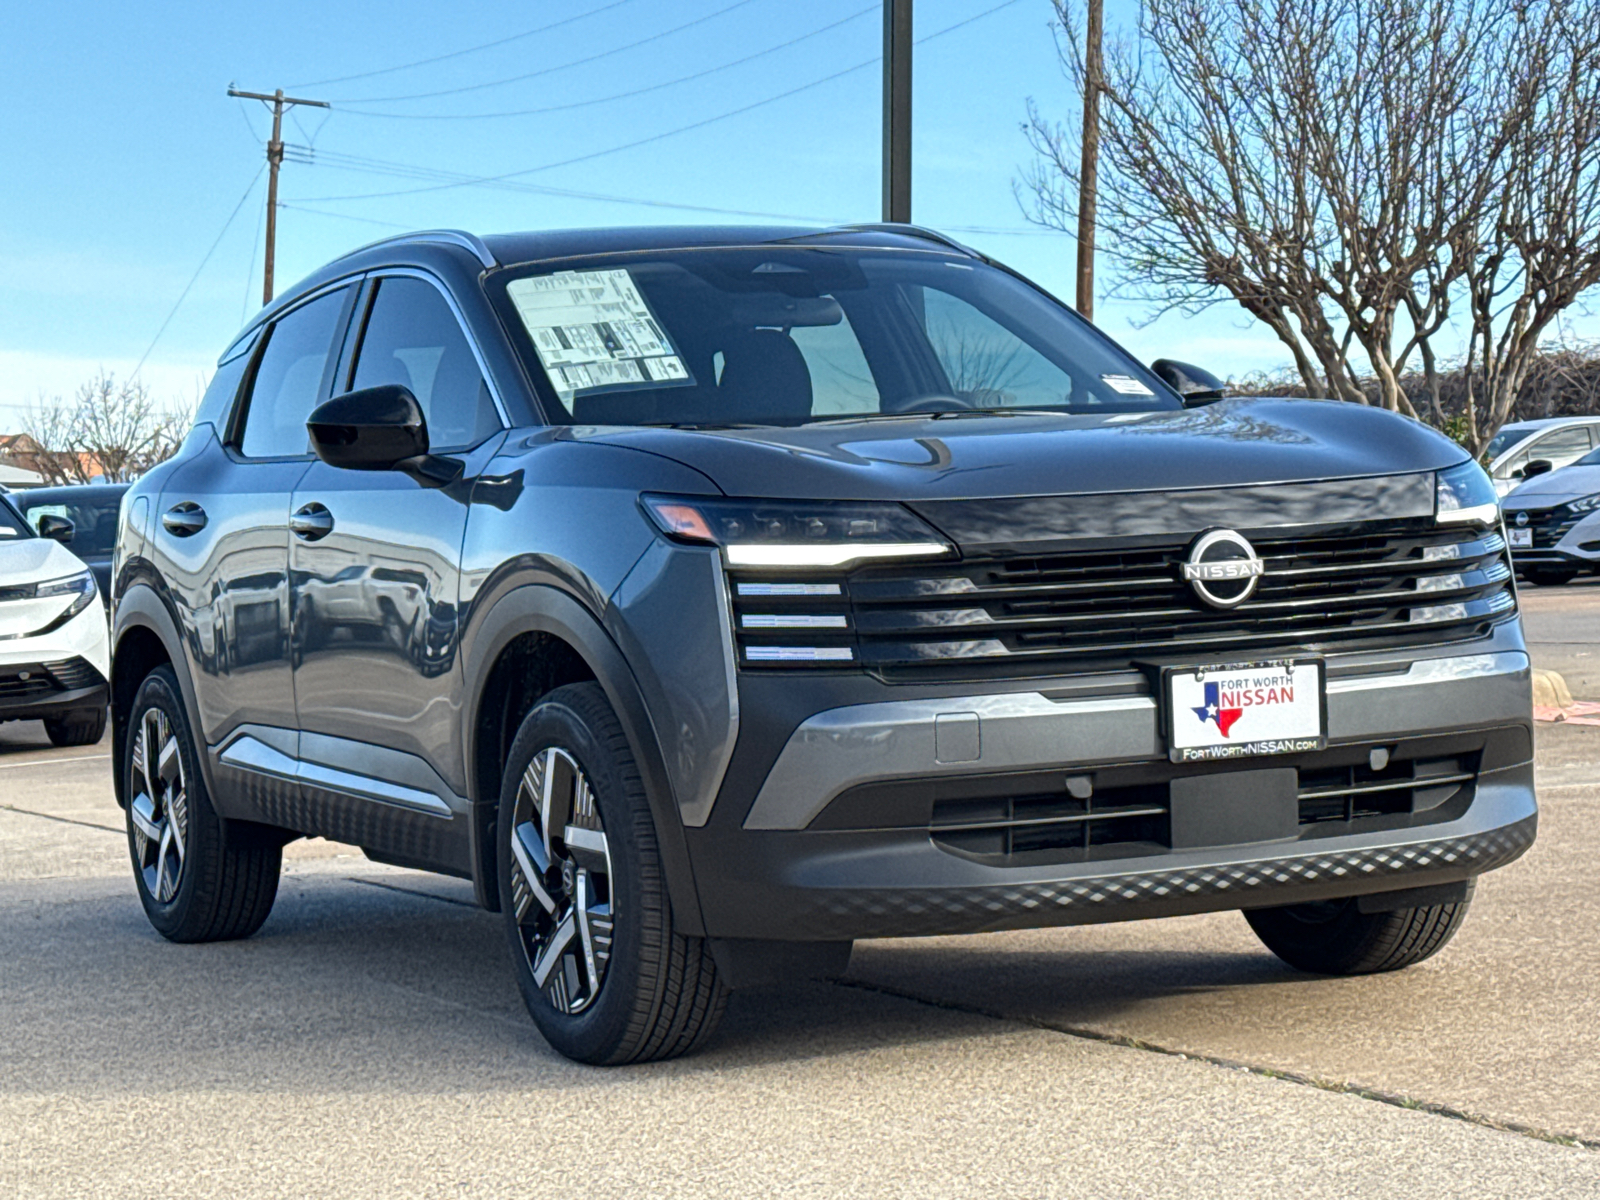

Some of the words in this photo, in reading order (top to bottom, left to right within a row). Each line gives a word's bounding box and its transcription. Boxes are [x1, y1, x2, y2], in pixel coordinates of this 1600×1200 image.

[1186, 561, 1263, 579] NISSAN
[1221, 679, 1249, 690] FORT
[1253, 676, 1293, 687] WORTH
[1221, 687, 1294, 707] NISSAN
